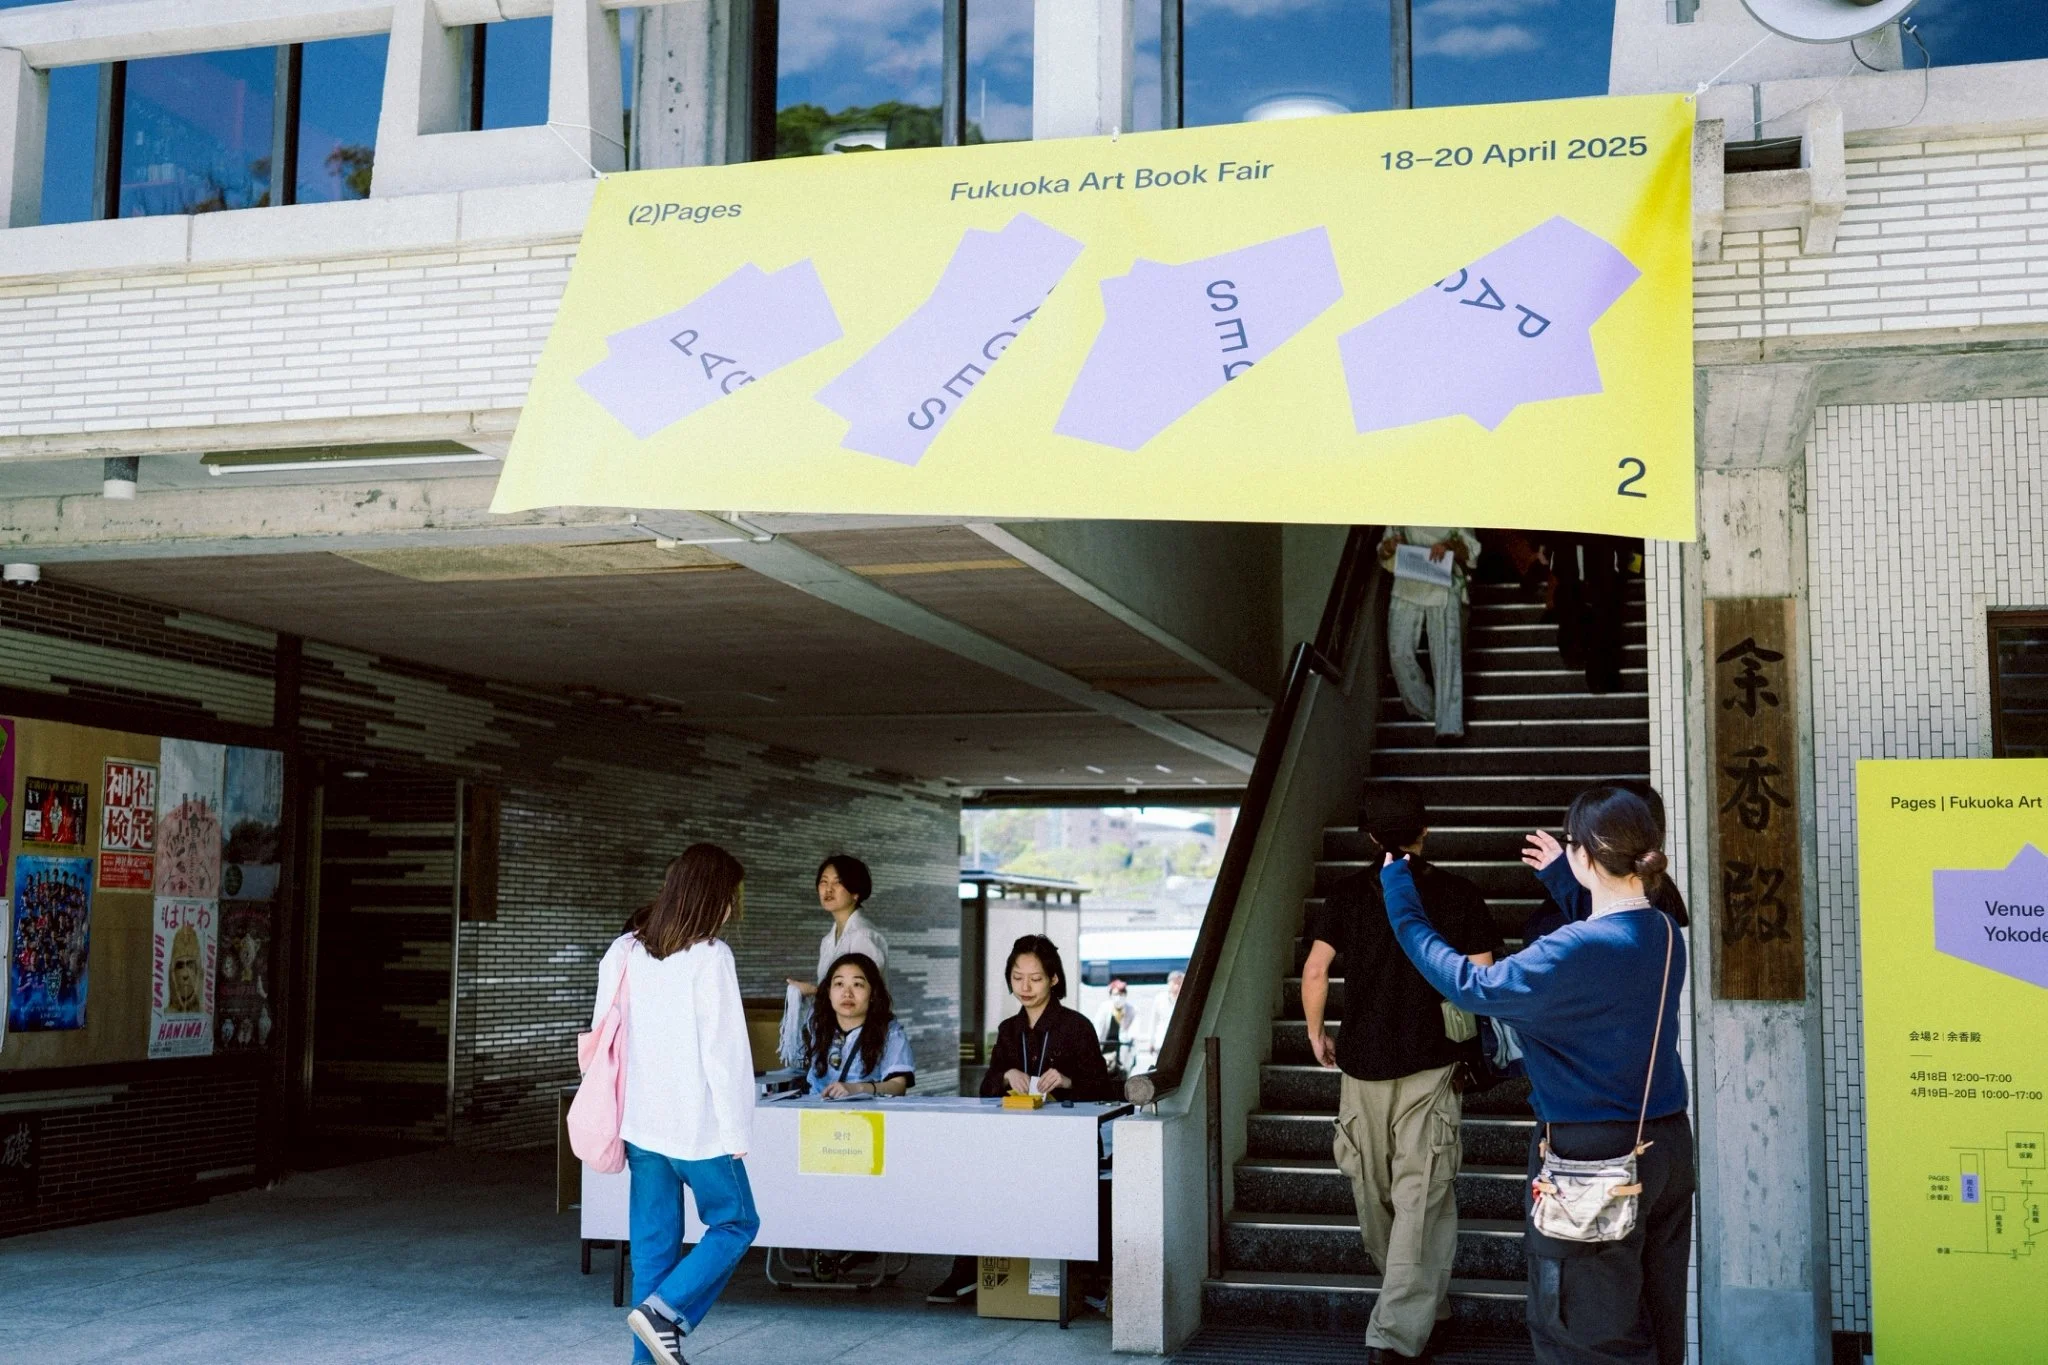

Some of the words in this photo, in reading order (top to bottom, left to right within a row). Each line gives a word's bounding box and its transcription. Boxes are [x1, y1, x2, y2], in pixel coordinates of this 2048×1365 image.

[1381, 146, 1474, 170] 18–20
[1483, 139, 1557, 168] April
[1567, 135, 1648, 160] 2025
[951, 175, 1070, 201] Fukuoka
[1079, 171, 1125, 192] Art
[1134, 164, 1207, 189] Book
[1218, 159, 1275, 182] Fair
[628, 203, 742, 225] (2)Pages
[1617, 457, 1647, 499] 2
[1890, 796, 1937, 812] Pages
[1950, 796, 2014, 809] Fukuoka
[2018, 796, 2043, 809] Art
[163, 904, 211, 929] はにわ
[1984, 900, 2045, 918] Venue
[1984, 925, 2048, 943] Yokode
[1910, 1070, 1948, 1082] 4月18日
[1952, 1072, 2013, 1083] 12:00–17:00
[1981, 1089, 2043, 1101] 10:00–17:00
[822, 1146, 863, 1157] Reception
